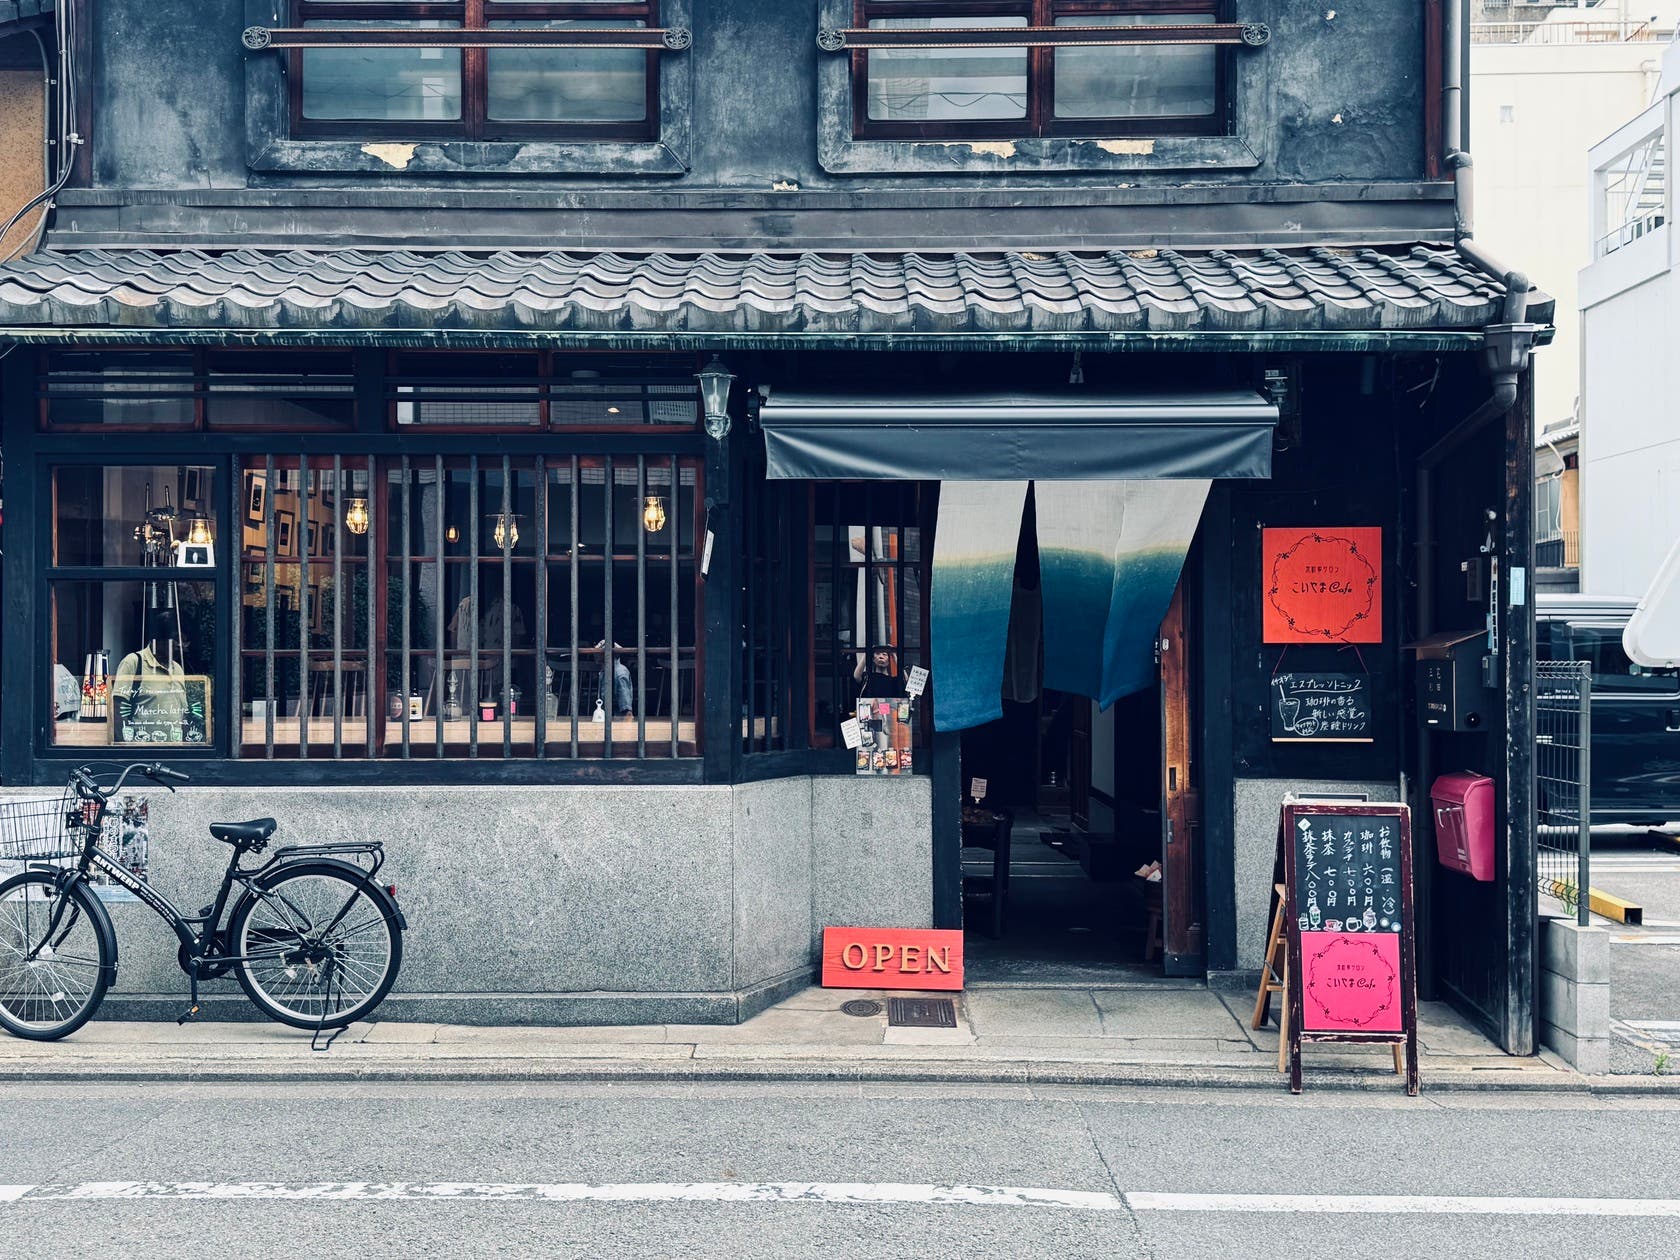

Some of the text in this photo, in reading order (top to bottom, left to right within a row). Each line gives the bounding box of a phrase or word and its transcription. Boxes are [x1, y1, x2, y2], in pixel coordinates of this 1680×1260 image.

[1290, 679, 1362, 690] エスプレッソトニック
[1320, 720, 1365, 731] 炭酸ドリンク
[1321, 828, 1336, 856] 抹茶
[1379, 825, 1392, 859] お飲物
[93, 854, 140, 889] ANTWERP
[842, 942, 951, 973] OPEN
